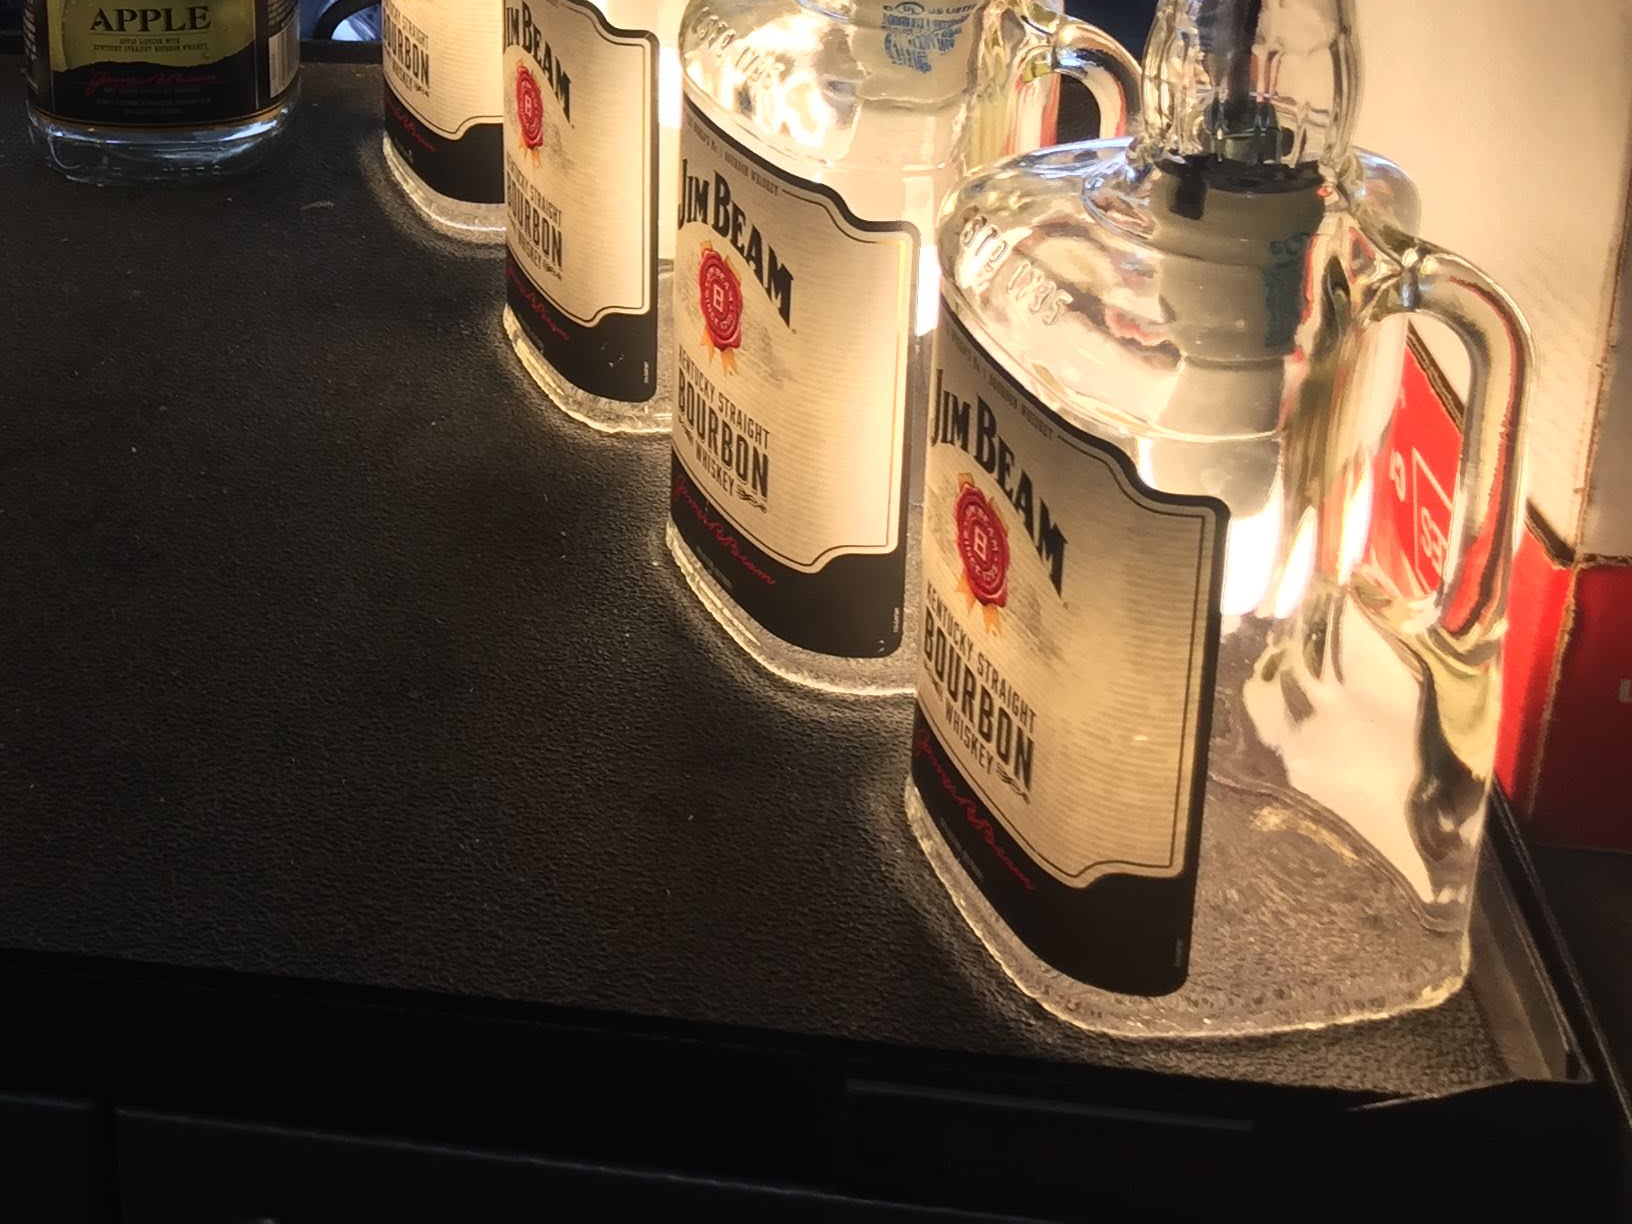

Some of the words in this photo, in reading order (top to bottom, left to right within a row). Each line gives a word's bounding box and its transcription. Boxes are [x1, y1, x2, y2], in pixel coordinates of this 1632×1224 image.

[89, 5, 212, 33] APPLE
[521, 0, 573, 126] BEAM
[678, 157, 710, 231] JIM
[711, 169, 795, 329] BEAM
[678, 344, 716, 405] KENTUCKY
[718, 391, 770, 451] STRAIGHT
[678, 365, 769, 499] BOURBON
[694, 440, 736, 498] WHISKEY
[930, 368, 971, 452] JIM
[973, 392, 1069, 601] BEAM
[923, 605, 1035, 793] BOURBON
[927, 578, 975, 659] KENTUCKY
[976, 652, 1037, 735] STRAIGHT
[944, 696, 994, 776] WHISKEY
